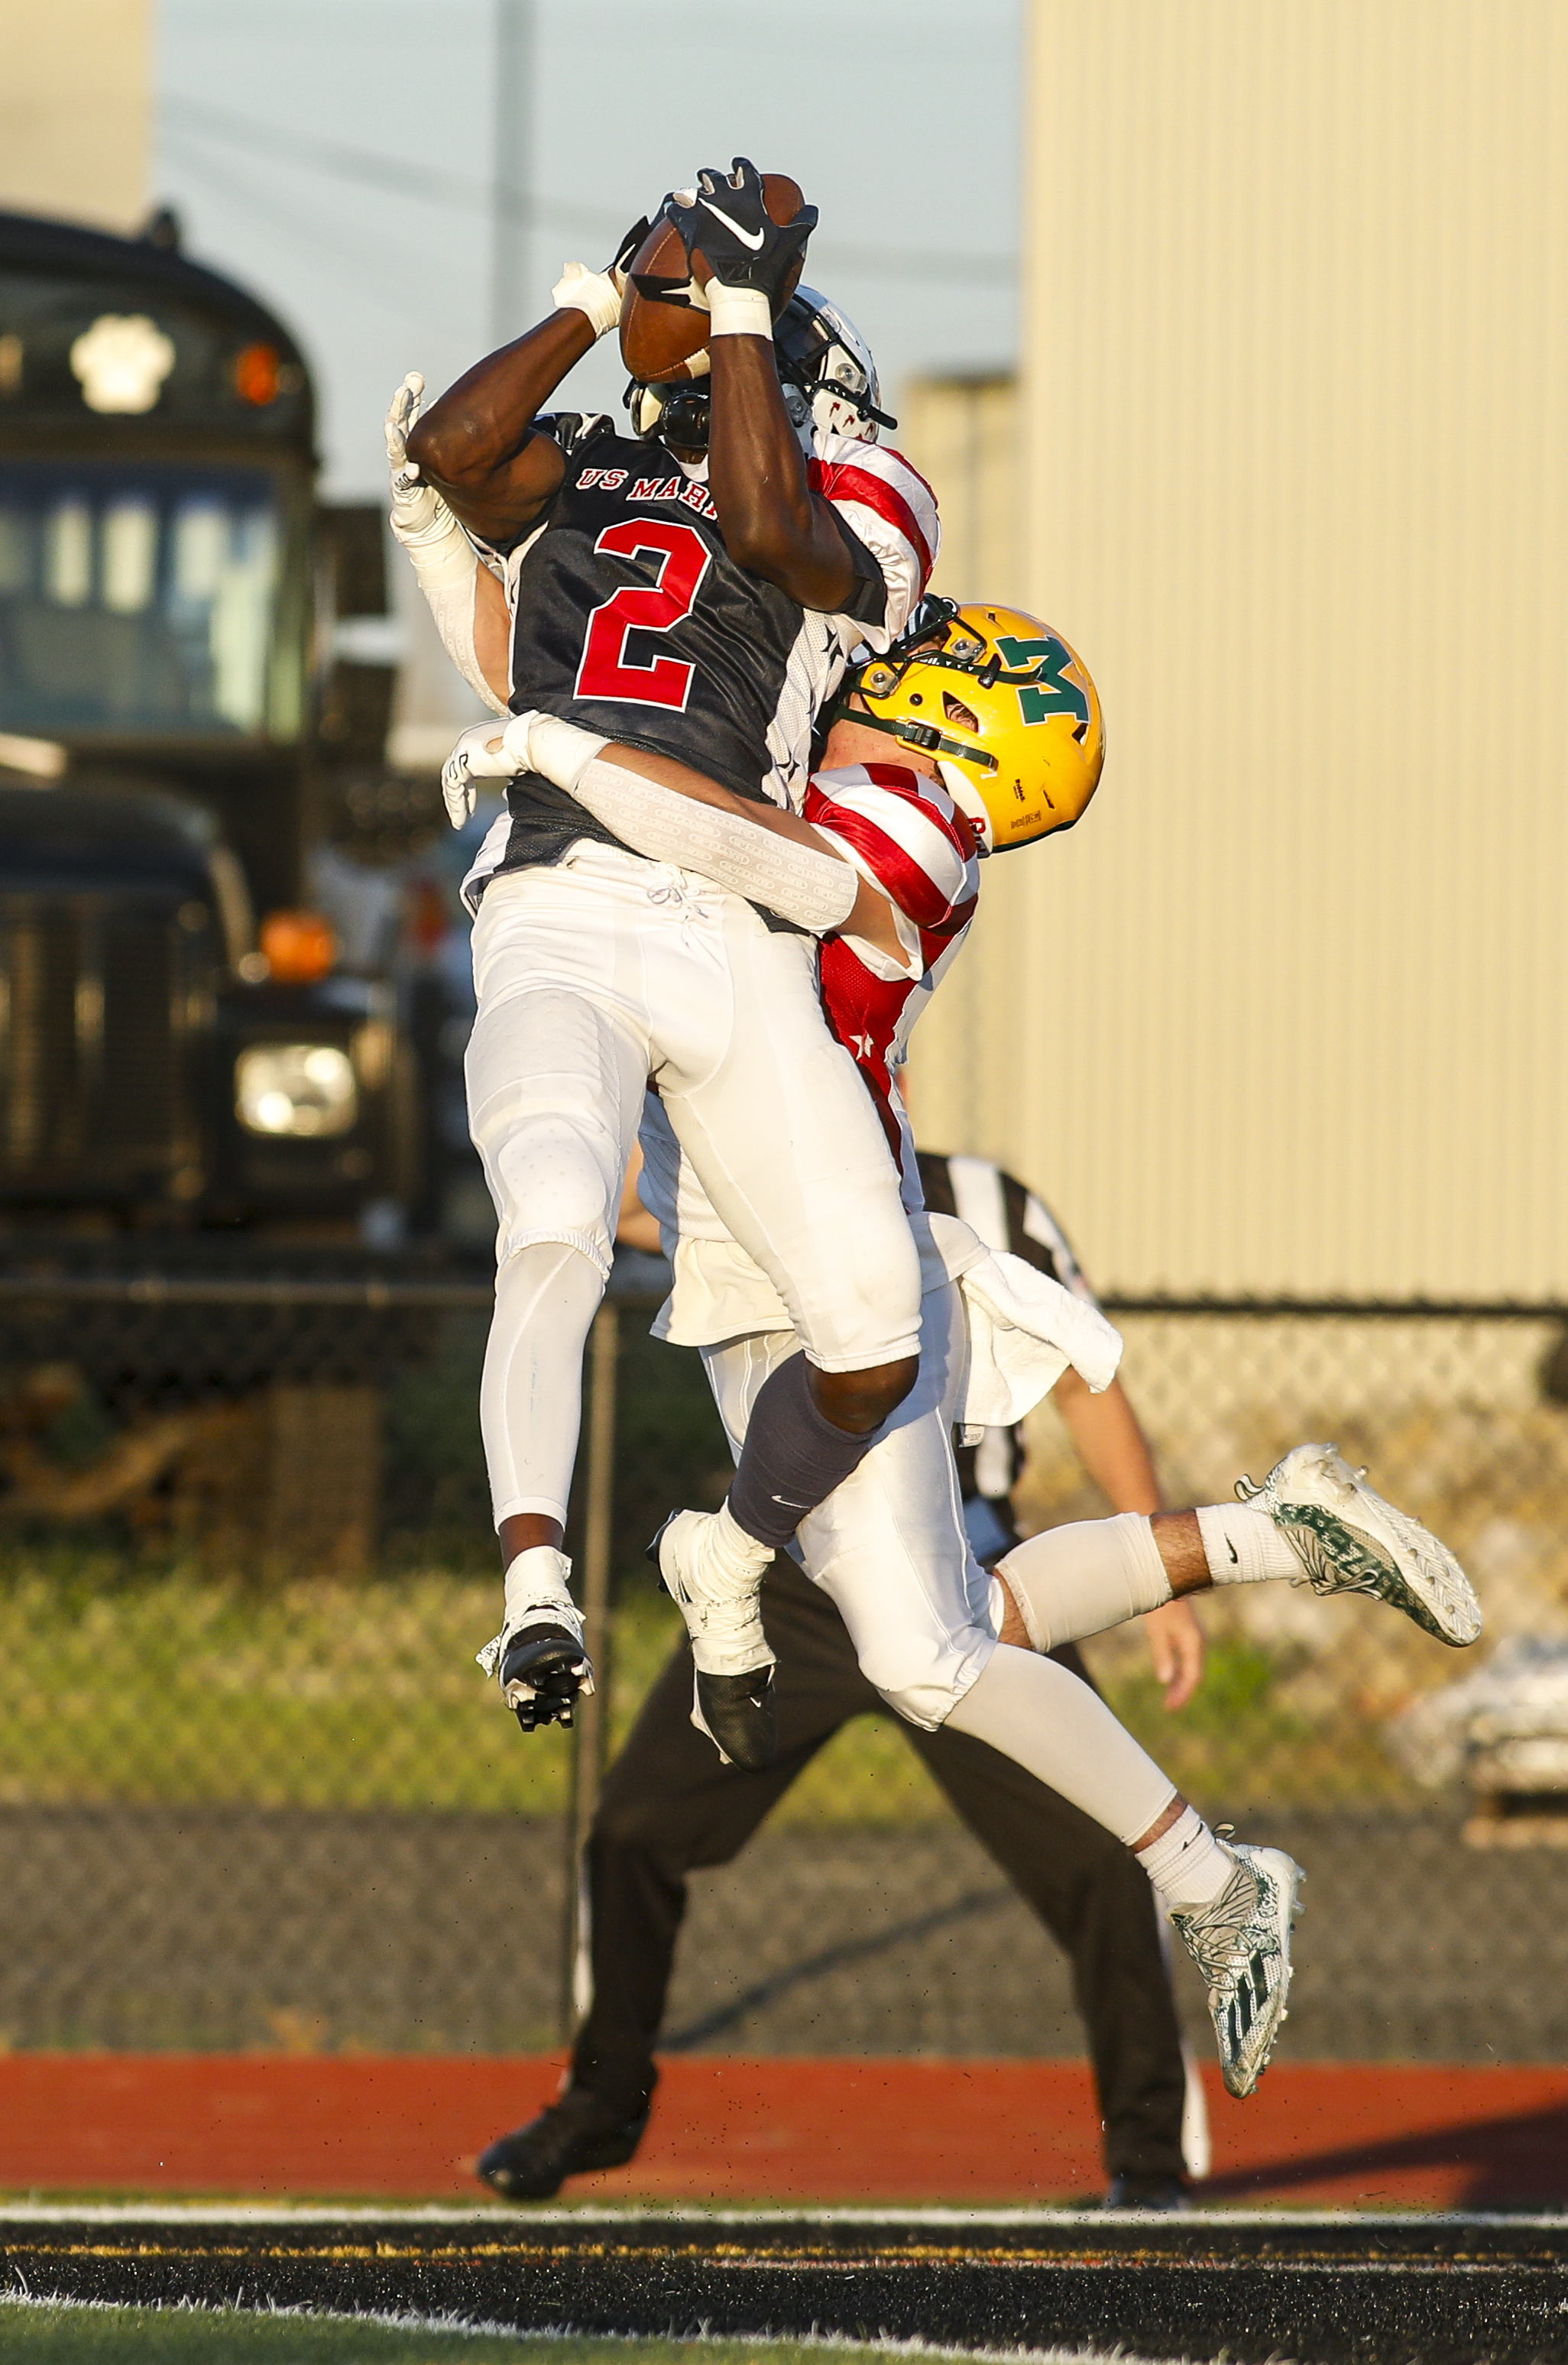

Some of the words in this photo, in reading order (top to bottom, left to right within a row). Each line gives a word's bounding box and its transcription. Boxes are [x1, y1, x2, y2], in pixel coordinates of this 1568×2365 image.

[575, 468, 629, 491] US
[573, 517, 712, 714] 2
[993, 634, 1090, 727] M
